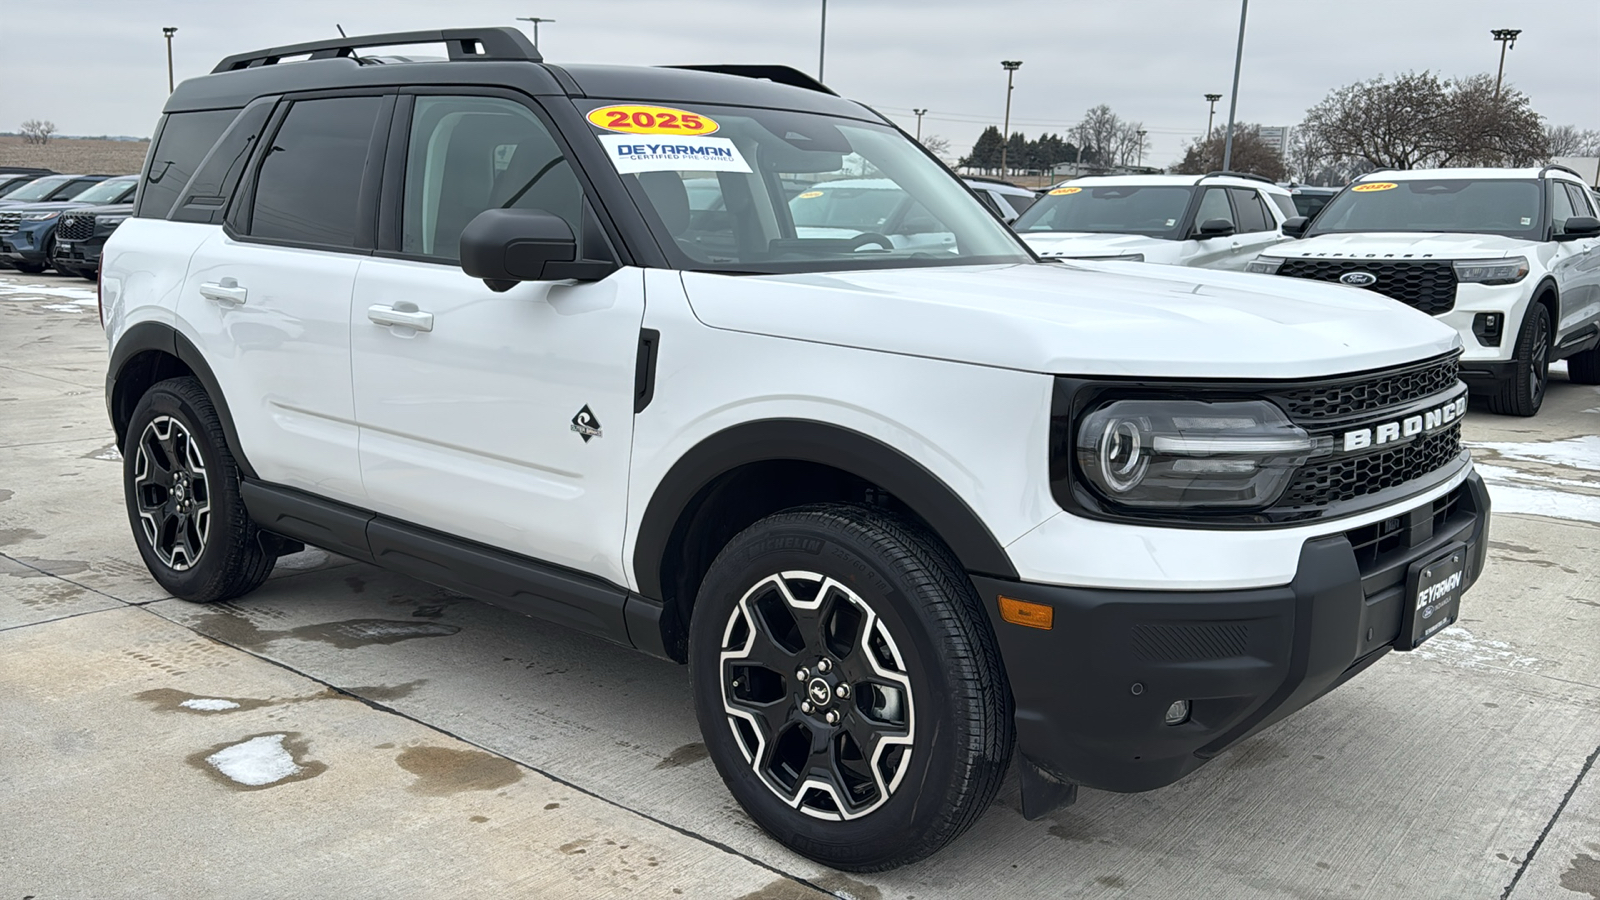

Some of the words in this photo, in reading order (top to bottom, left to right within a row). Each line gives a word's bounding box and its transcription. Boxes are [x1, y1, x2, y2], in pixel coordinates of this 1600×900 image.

[605, 110, 705, 131] 2025
[617, 143, 732, 158] DEYARMAN
[630, 153, 680, 161] CERTIFIED
[682, 154, 735, 162] PRE-OWNED
[1347, 274, 1368, 284] Ford
[1343, 396, 1466, 452] BRONCO
[1416, 570, 1462, 611] DEYARMAN
